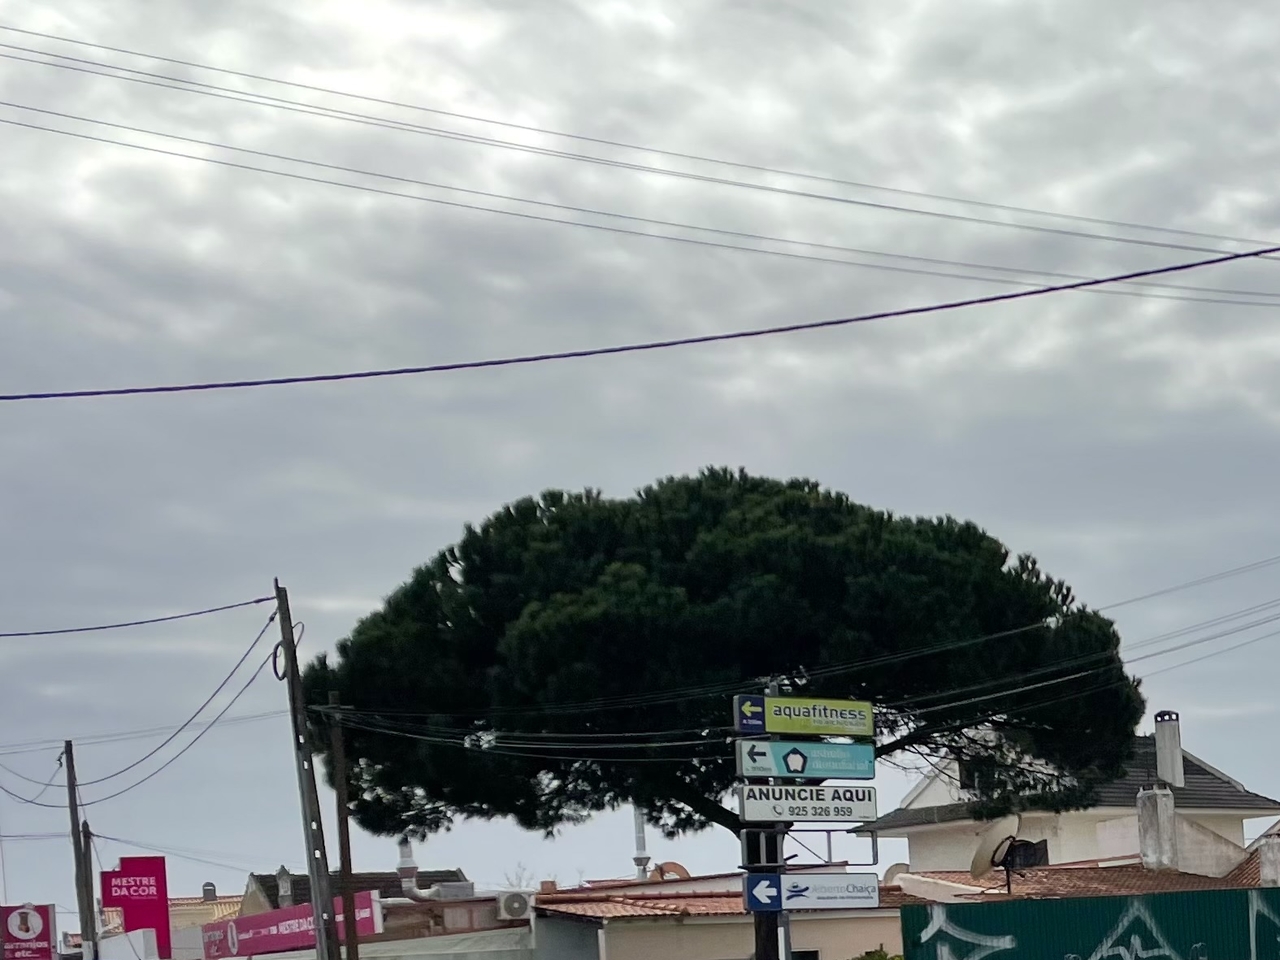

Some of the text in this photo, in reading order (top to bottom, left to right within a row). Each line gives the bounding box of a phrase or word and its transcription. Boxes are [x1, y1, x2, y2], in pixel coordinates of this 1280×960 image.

[773, 705, 867, 720] aquafitness
[746, 787, 872, 803] ANUNCIE AQUI
[788, 805, 853, 817] 925 326 959
[111, 877, 157, 886] MESTRE
[111, 886, 157, 897] DA COR
